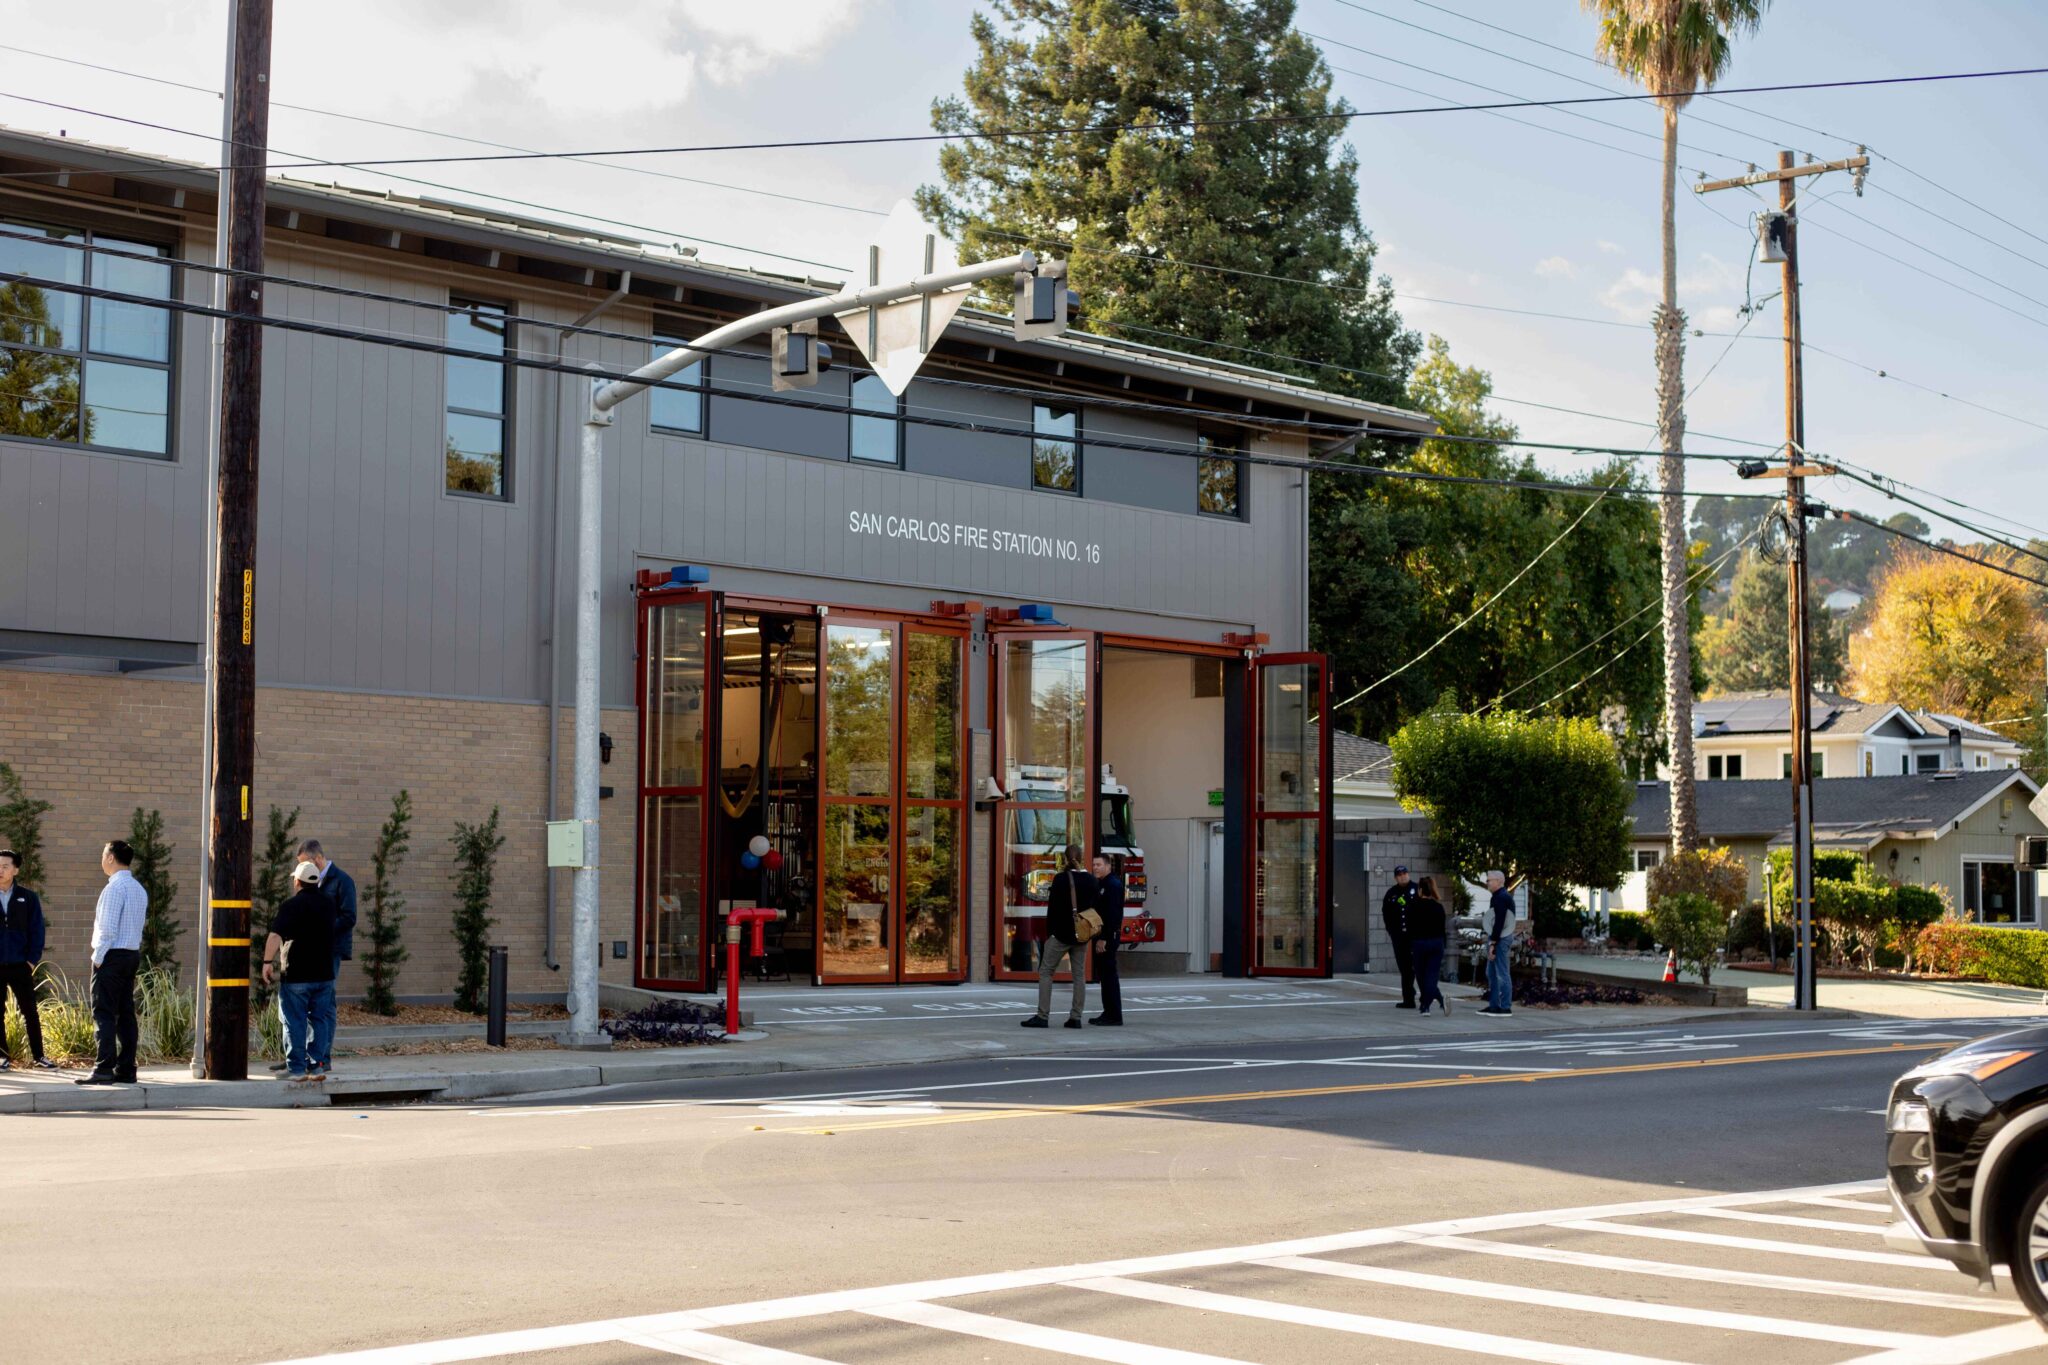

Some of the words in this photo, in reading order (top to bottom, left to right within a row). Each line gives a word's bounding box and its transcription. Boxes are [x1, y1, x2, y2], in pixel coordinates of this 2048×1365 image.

[849, 511, 882, 535] SAN
[886, 516, 950, 544] CARLOS
[954, 525, 988, 549] FIRE
[992, 530, 1052, 558] STATION
[1056, 539, 1081, 562] NO.
[1085, 544, 1100, 564] 16
[865, 857, 888, 868] ENGIN
[869, 874, 889, 893] 16
[778, 1005, 887, 1015] KEEP
[912, 1001, 1039, 1011] CLEAR
